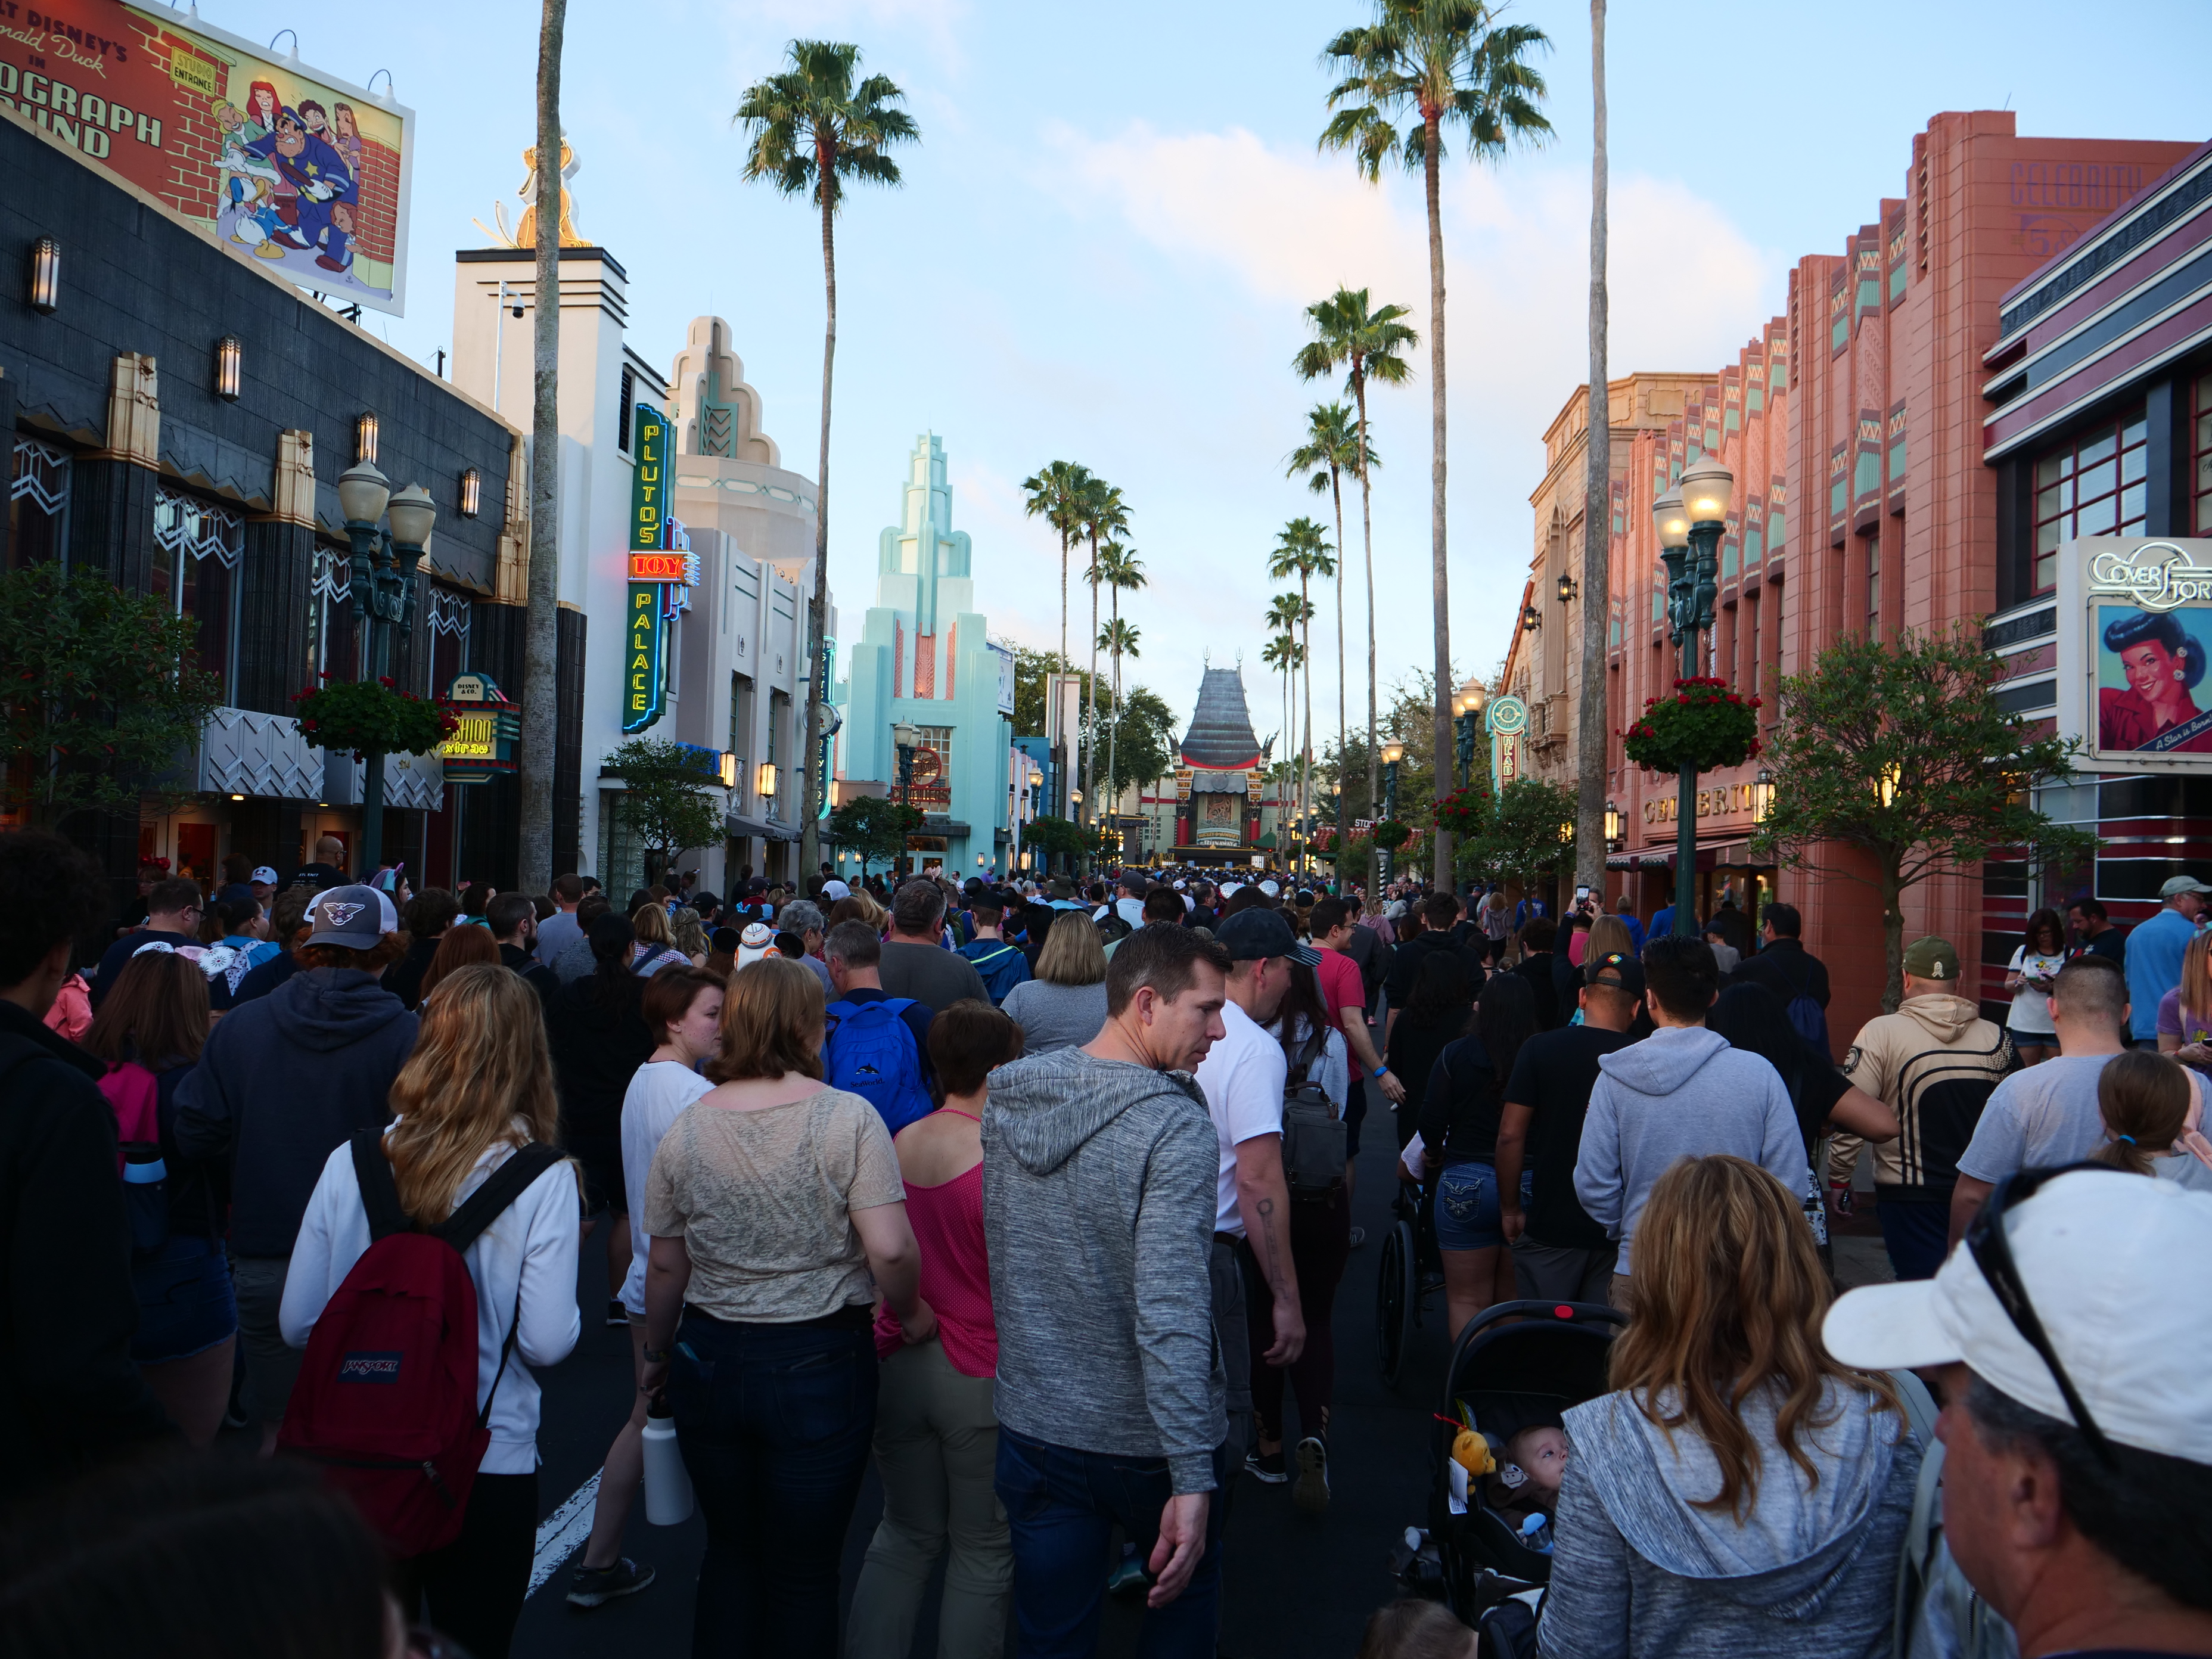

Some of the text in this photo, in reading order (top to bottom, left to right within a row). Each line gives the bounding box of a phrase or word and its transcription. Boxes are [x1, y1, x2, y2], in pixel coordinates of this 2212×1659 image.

[27, 10, 128, 62] DISNEY'S
[29, 55, 45, 70] IN
[51, 34, 107, 79] Duck
[176, 54, 213, 80] STUDIO
[174, 66, 212, 92] ENTRANCE
[2009, 162, 2142, 208] CELEBRITY
[639, 425, 660, 543] PLUTO'S
[633, 557, 682, 575] TOY
[2088, 552, 2162, 588] COVER
[2147, 557, 2212, 602] STOR
[632, 594, 651, 710] PALACE
[446, 718, 493, 742] SHION
[1503, 709, 1514, 719] &
[2156, 740, 2164, 751] A
[2164, 734, 2183, 747] Star
[2182, 728, 2191, 737] is
[1644, 781, 1755, 825] CELBRIT
